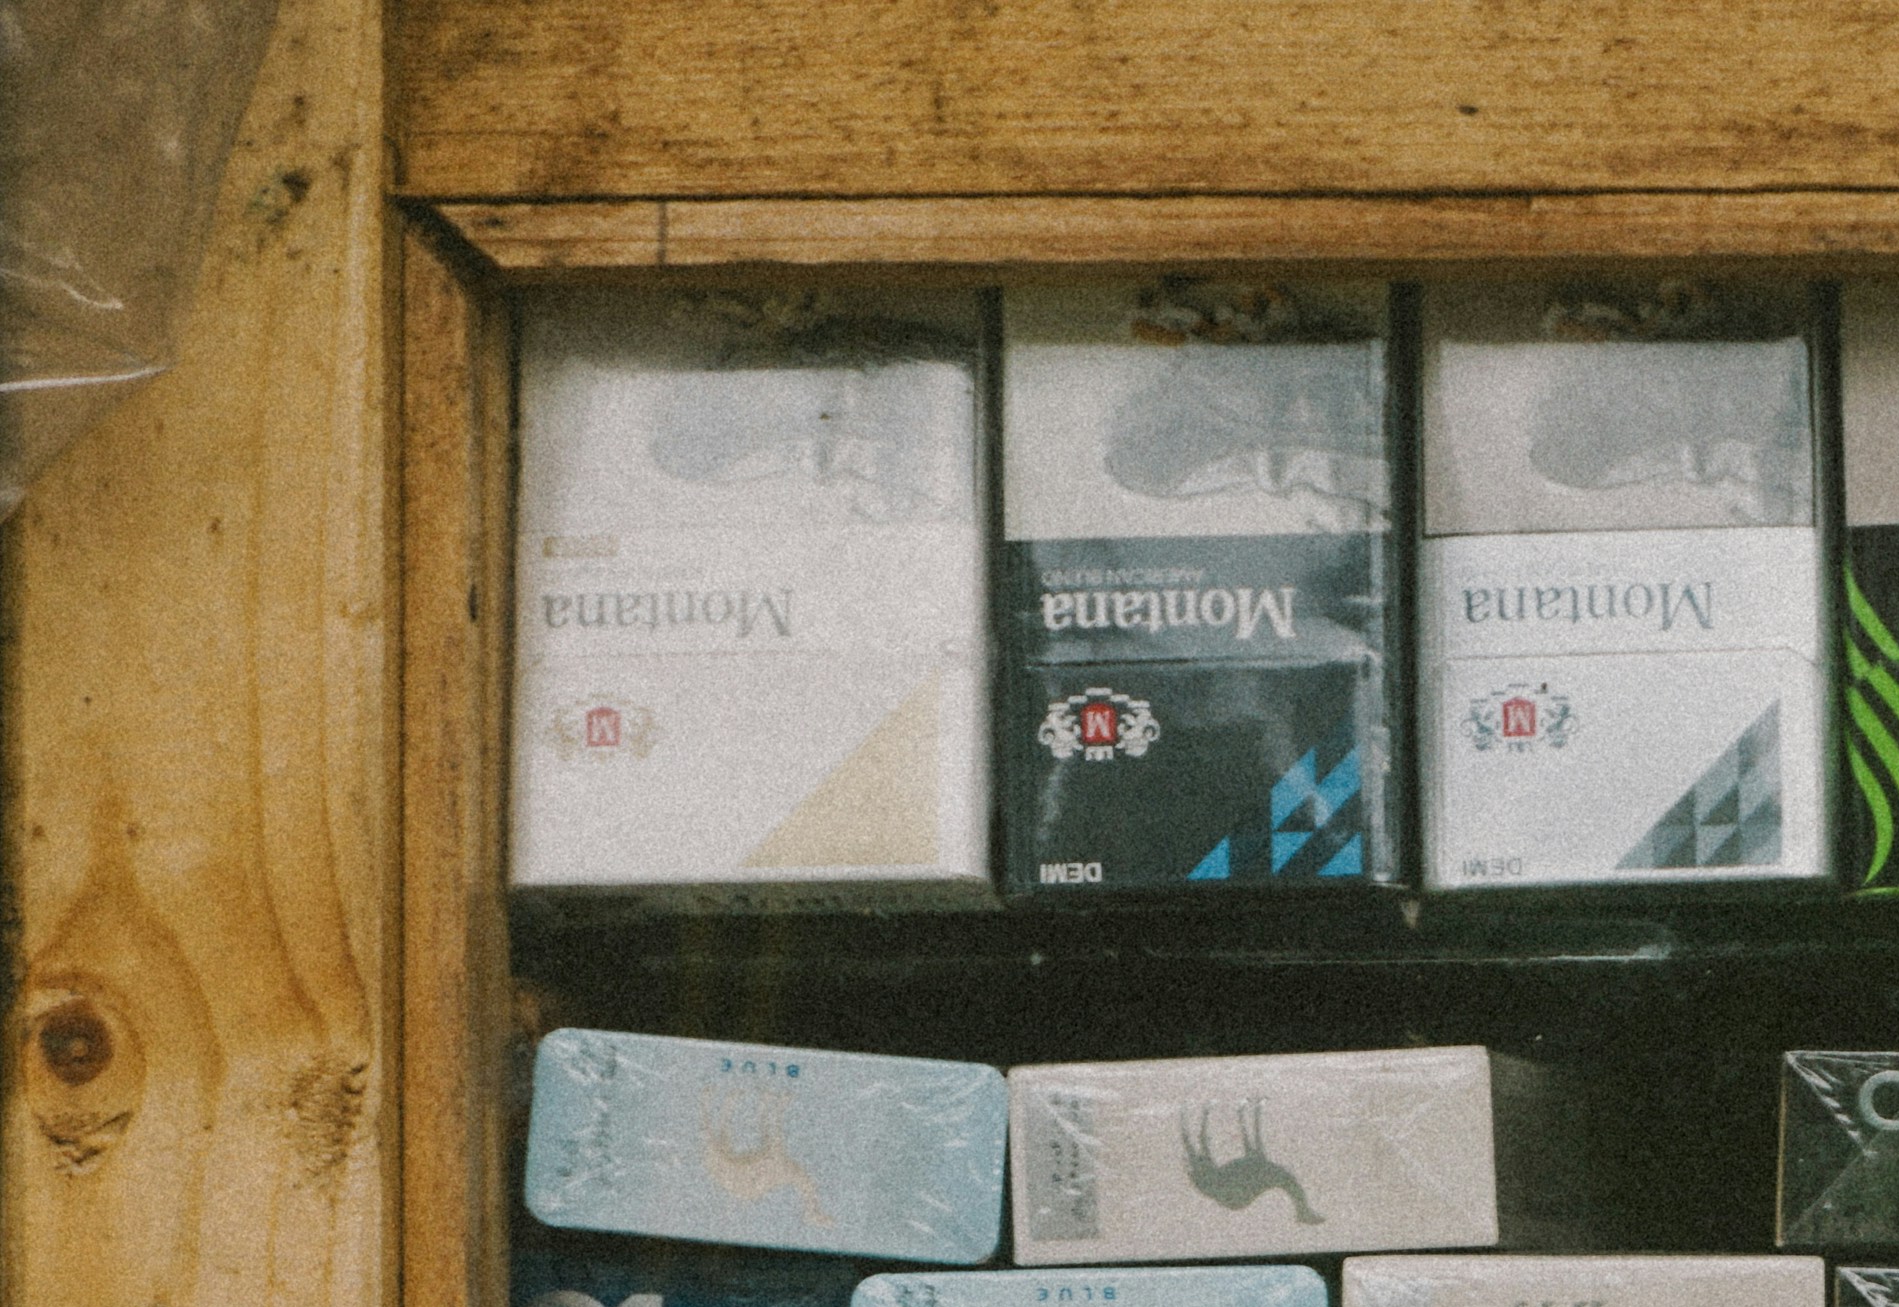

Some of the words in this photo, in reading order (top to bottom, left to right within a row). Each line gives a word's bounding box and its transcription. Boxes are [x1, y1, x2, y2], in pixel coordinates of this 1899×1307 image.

[544, 590, 792, 638] Montana
[1042, 588, 1297, 638] Montana
[1463, 582, 1713, 629] Montana
[1041, 862, 1102, 883] DEMI
[1462, 859, 1521, 877] DEMI
[721, 1058, 799, 1078] BLUE
[1038, 1286, 1115, 1302] BLUE
